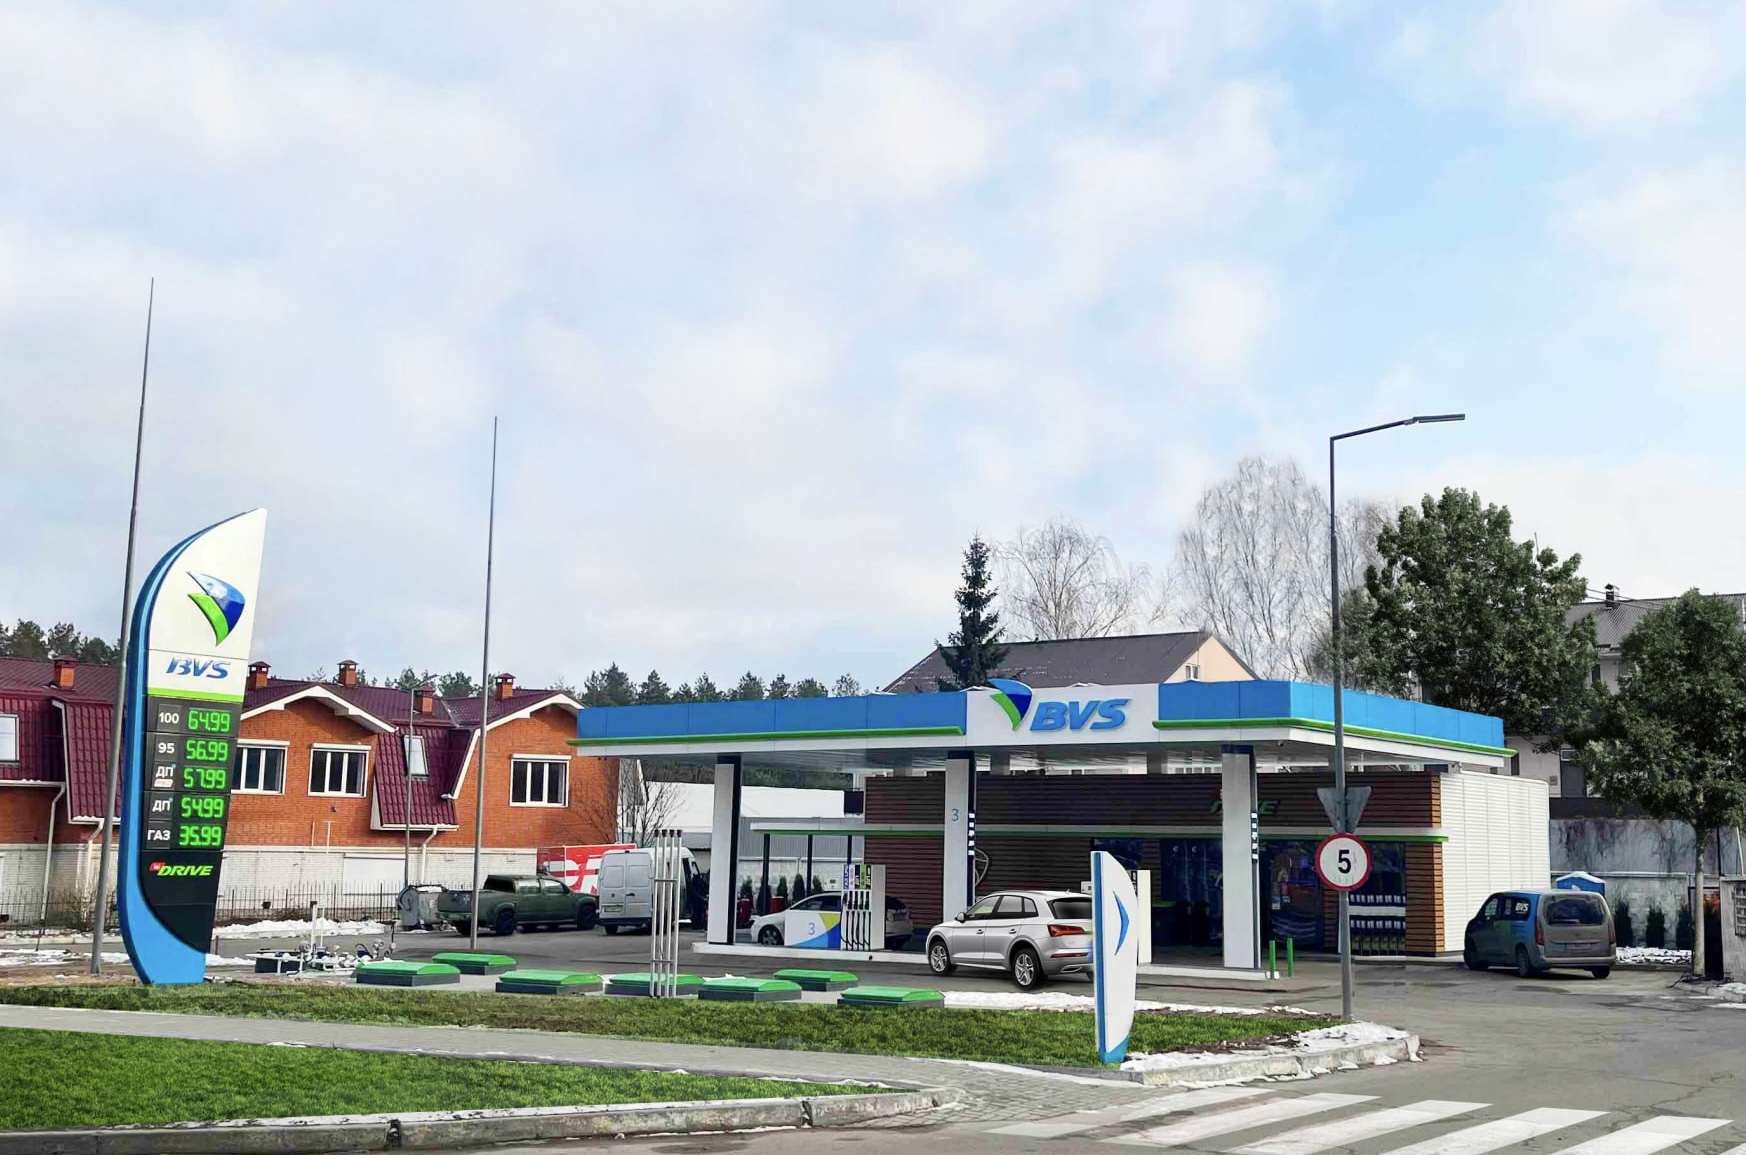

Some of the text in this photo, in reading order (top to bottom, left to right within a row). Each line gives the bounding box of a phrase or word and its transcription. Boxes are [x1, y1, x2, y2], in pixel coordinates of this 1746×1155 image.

[166, 657, 231, 679] BVS
[159, 710, 231, 732] 100 64.99
[1030, 699, 1131, 731] BVS
[158, 739, 229, 761] 95 56.99
[184, 768, 226, 789] 57.99
[181, 797, 224, 818] 54.99
[951, 808, 959, 821] 3
[147, 825, 222, 846] ГАЗ 35.99
[157, 865, 214, 876] DRIVE
[1337, 849, 1352, 874] 5
[807, 922, 816, 935] 3
